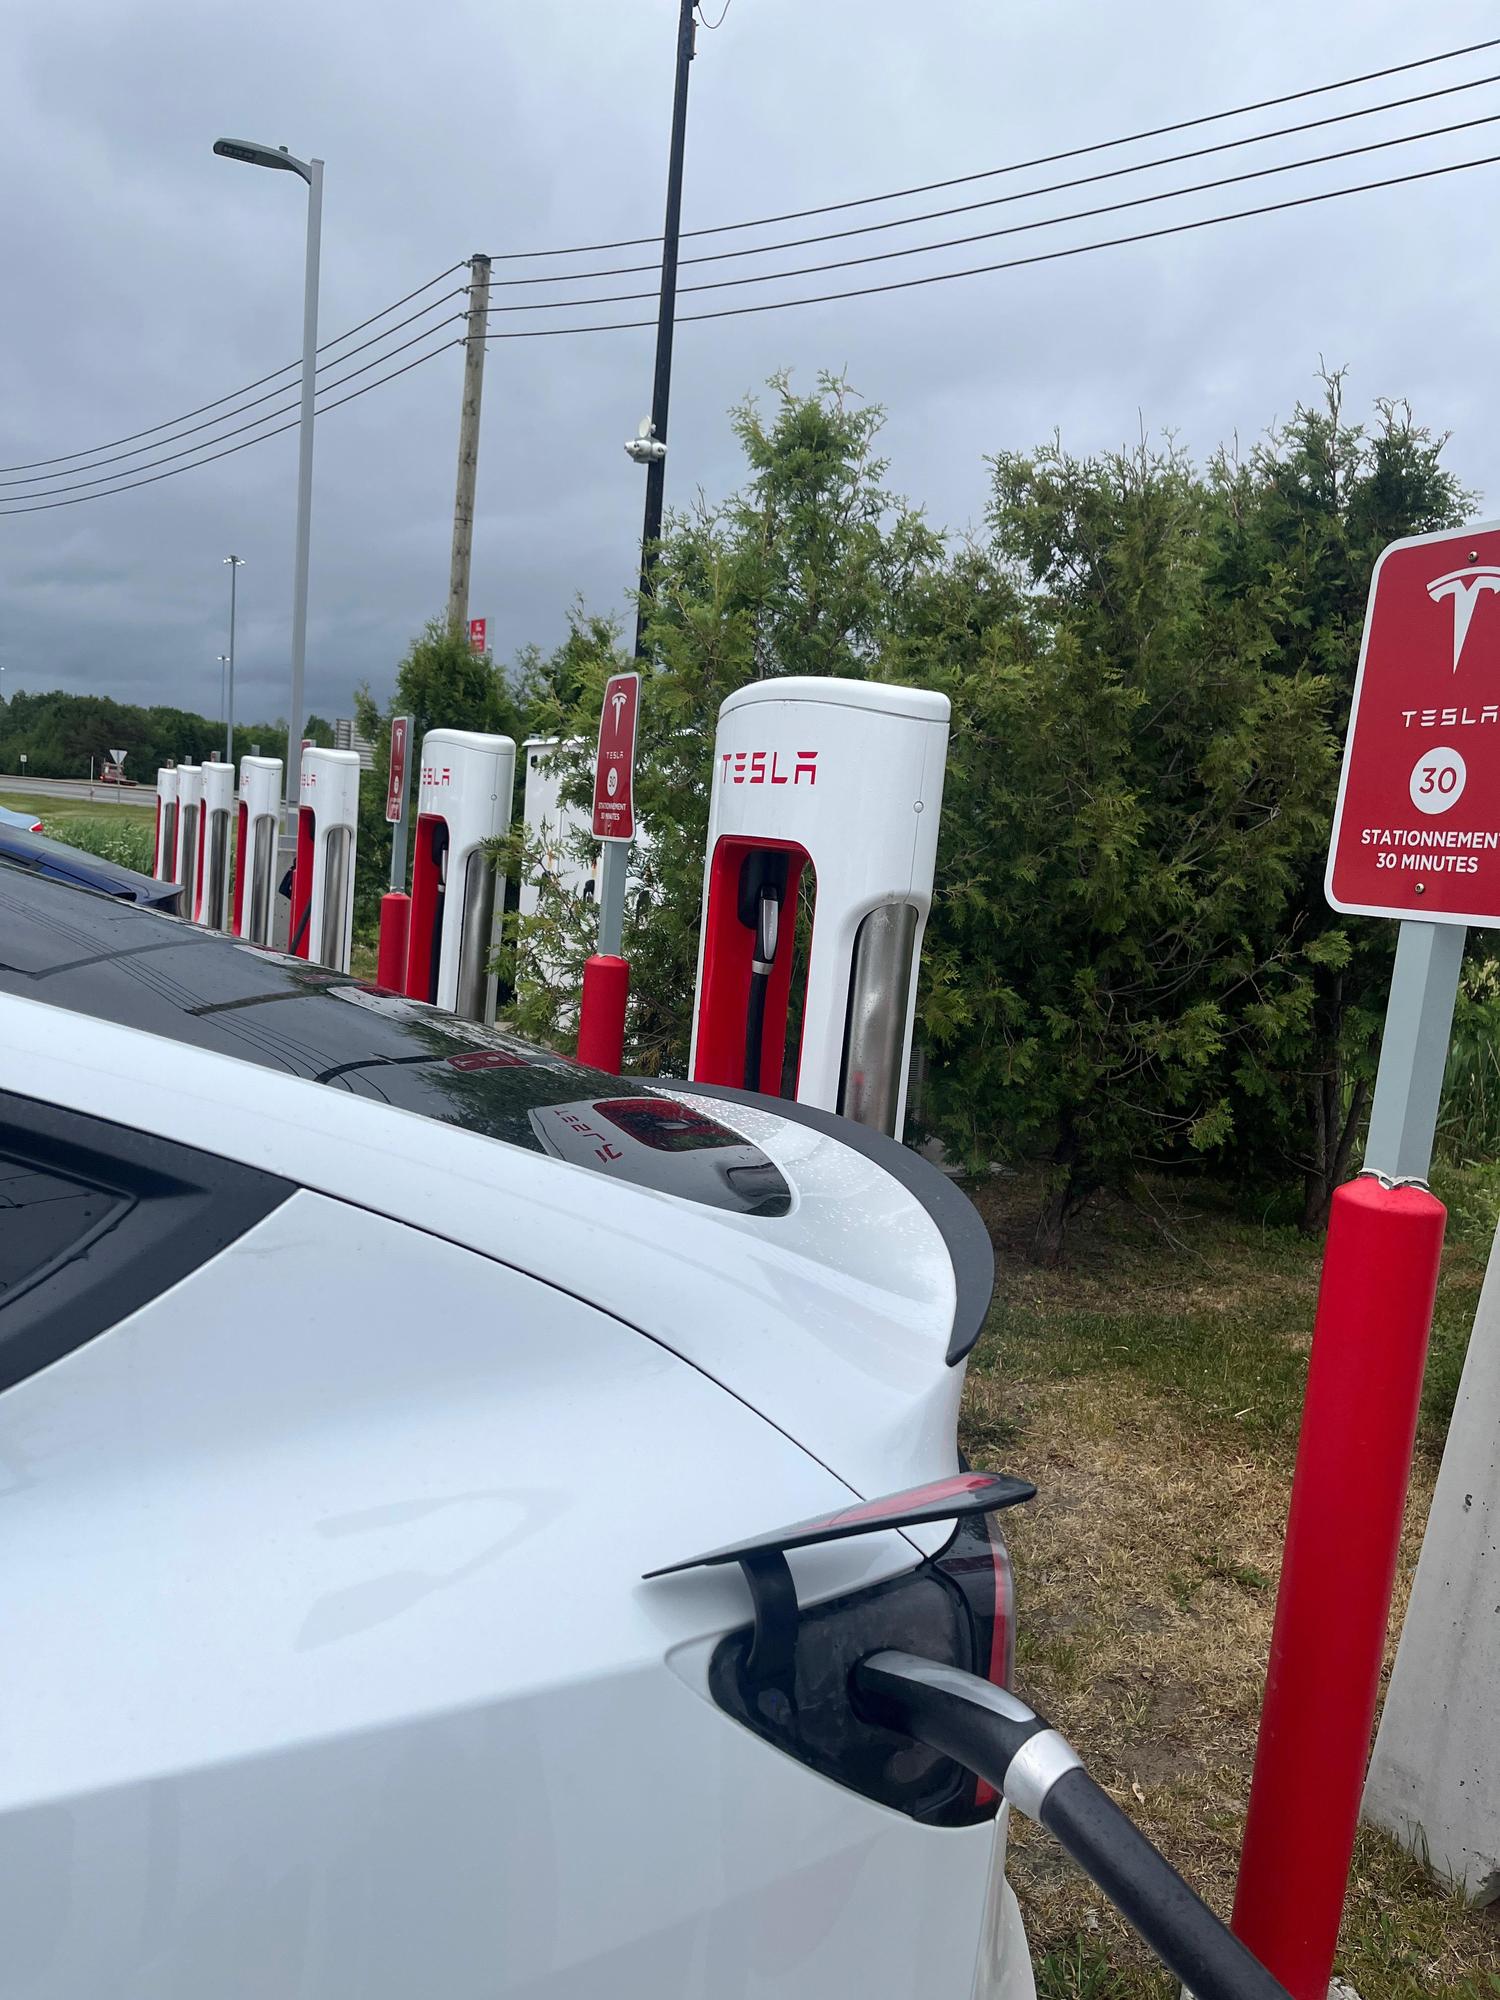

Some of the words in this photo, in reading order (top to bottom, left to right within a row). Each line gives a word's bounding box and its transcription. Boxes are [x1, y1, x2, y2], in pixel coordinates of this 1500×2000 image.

[1401, 705, 1499, 728] TESLA
[606, 751, 624, 759] TESLA
[422, 767, 450, 786] ESLA
[722, 751, 819, 784] TESLA
[1419, 767, 1457, 794] 30
[1361, 829, 1500, 849] STATIONNEMEN
[1376, 853, 1397, 869] 30
[1401, 854, 1479, 874] MINUTES
